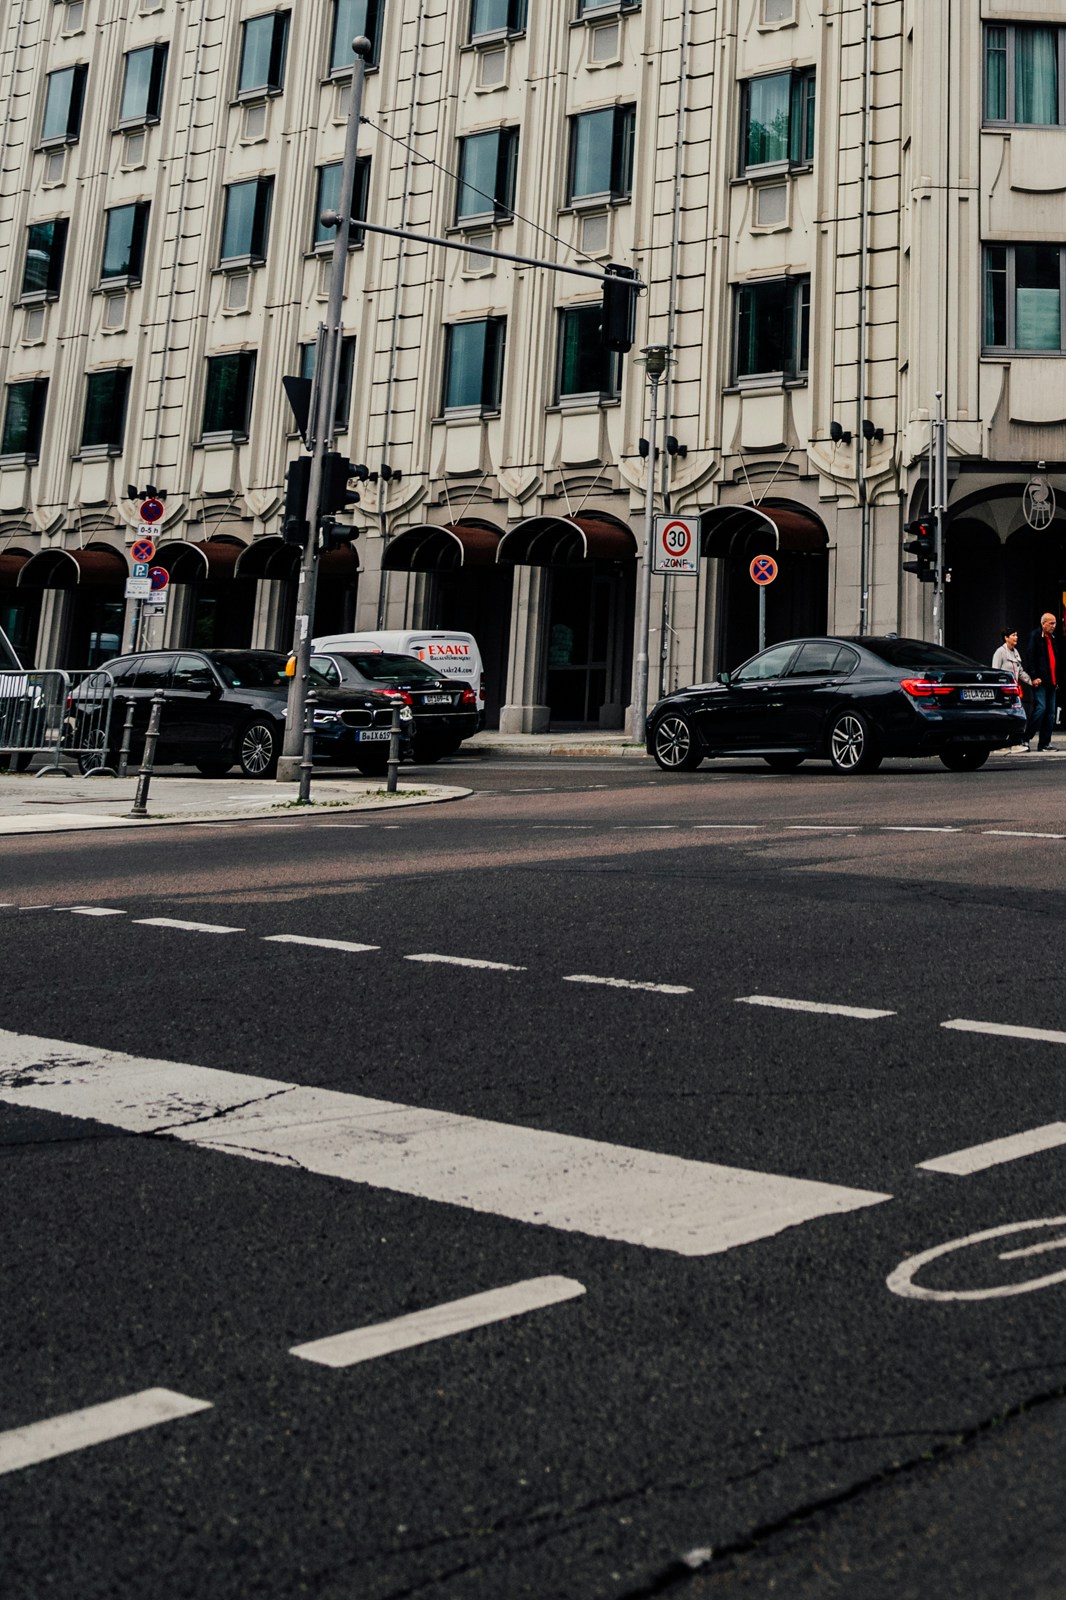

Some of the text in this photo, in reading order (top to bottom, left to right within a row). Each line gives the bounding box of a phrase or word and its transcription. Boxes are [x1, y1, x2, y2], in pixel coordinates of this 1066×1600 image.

[668, 530, 686, 547] 30
[665, 558, 688, 568] ZONE
[428, 645, 470, 655] EXAKT
